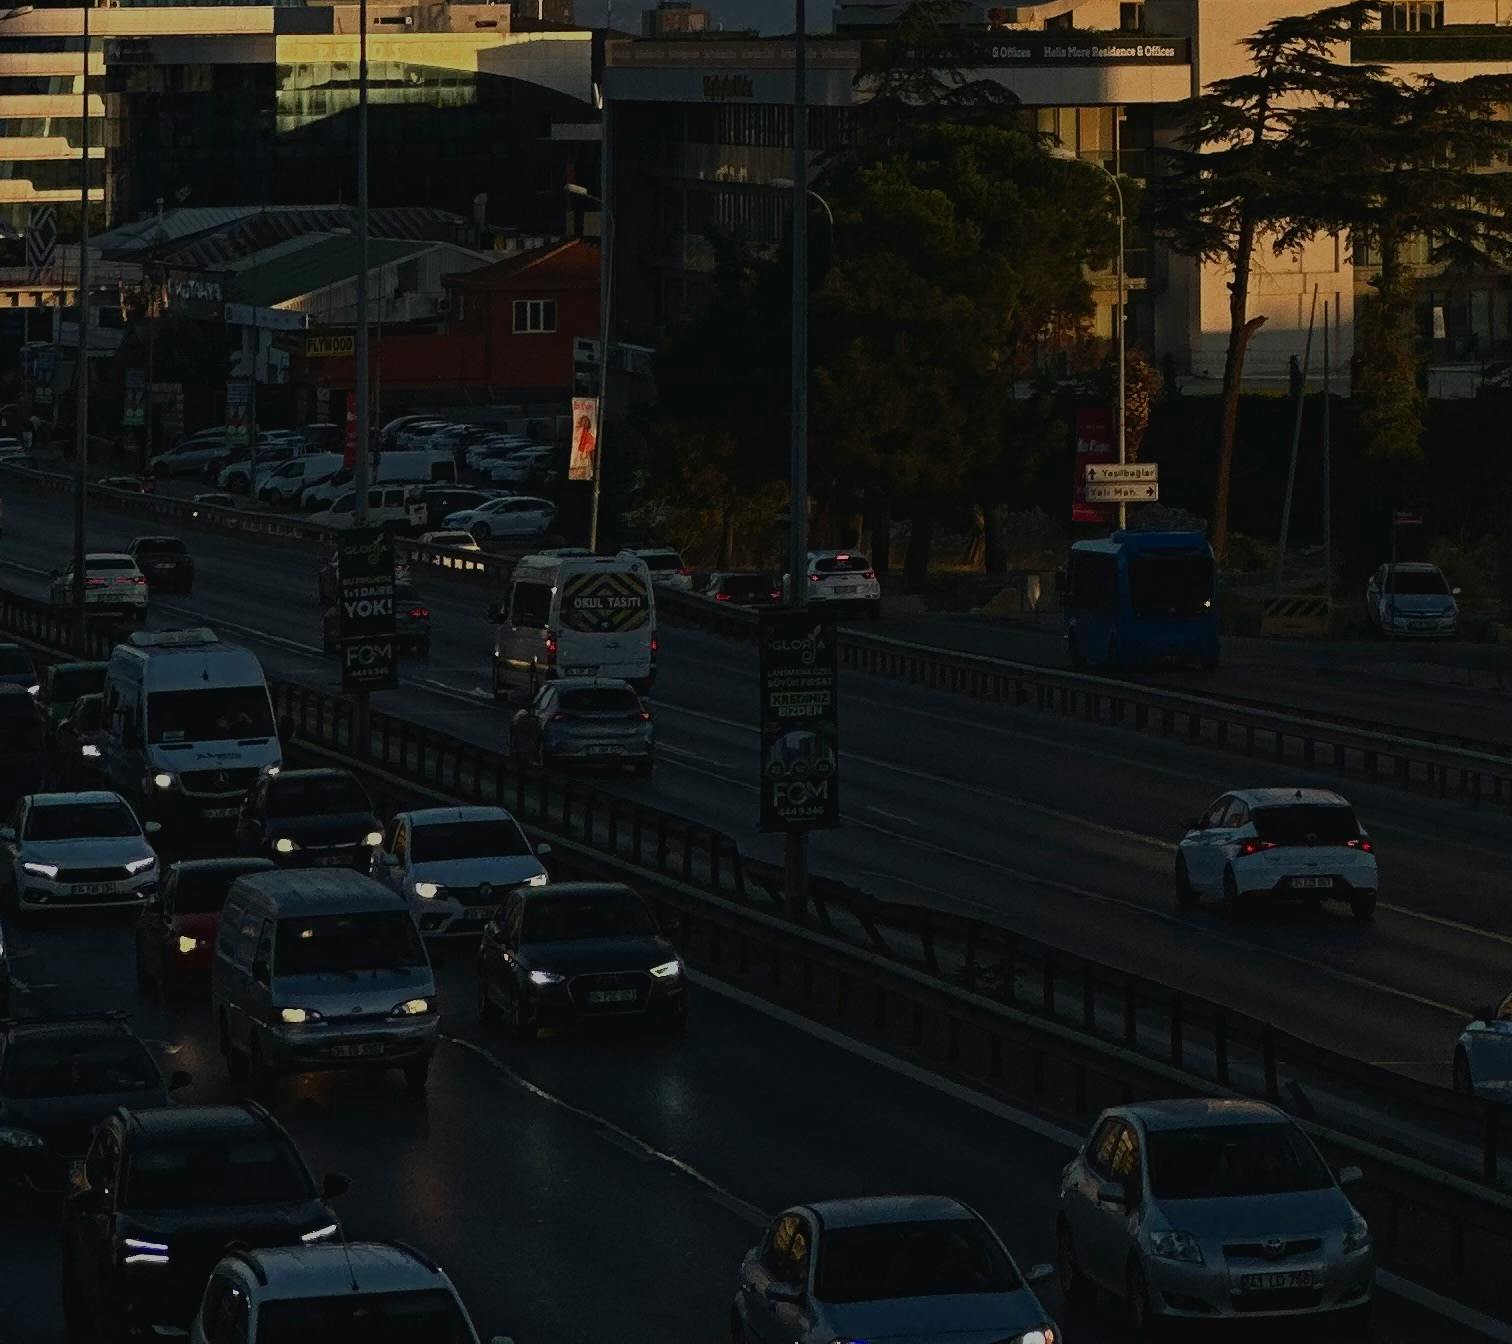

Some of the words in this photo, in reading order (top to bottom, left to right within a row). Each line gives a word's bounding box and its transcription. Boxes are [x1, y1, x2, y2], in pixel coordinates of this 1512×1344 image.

[1144, 45, 1175, 58] Offices
[307, 337, 354, 354] PLYWOOD
[344, 599, 393, 618] YOK!
[574, 597, 603, 608] OKUL
